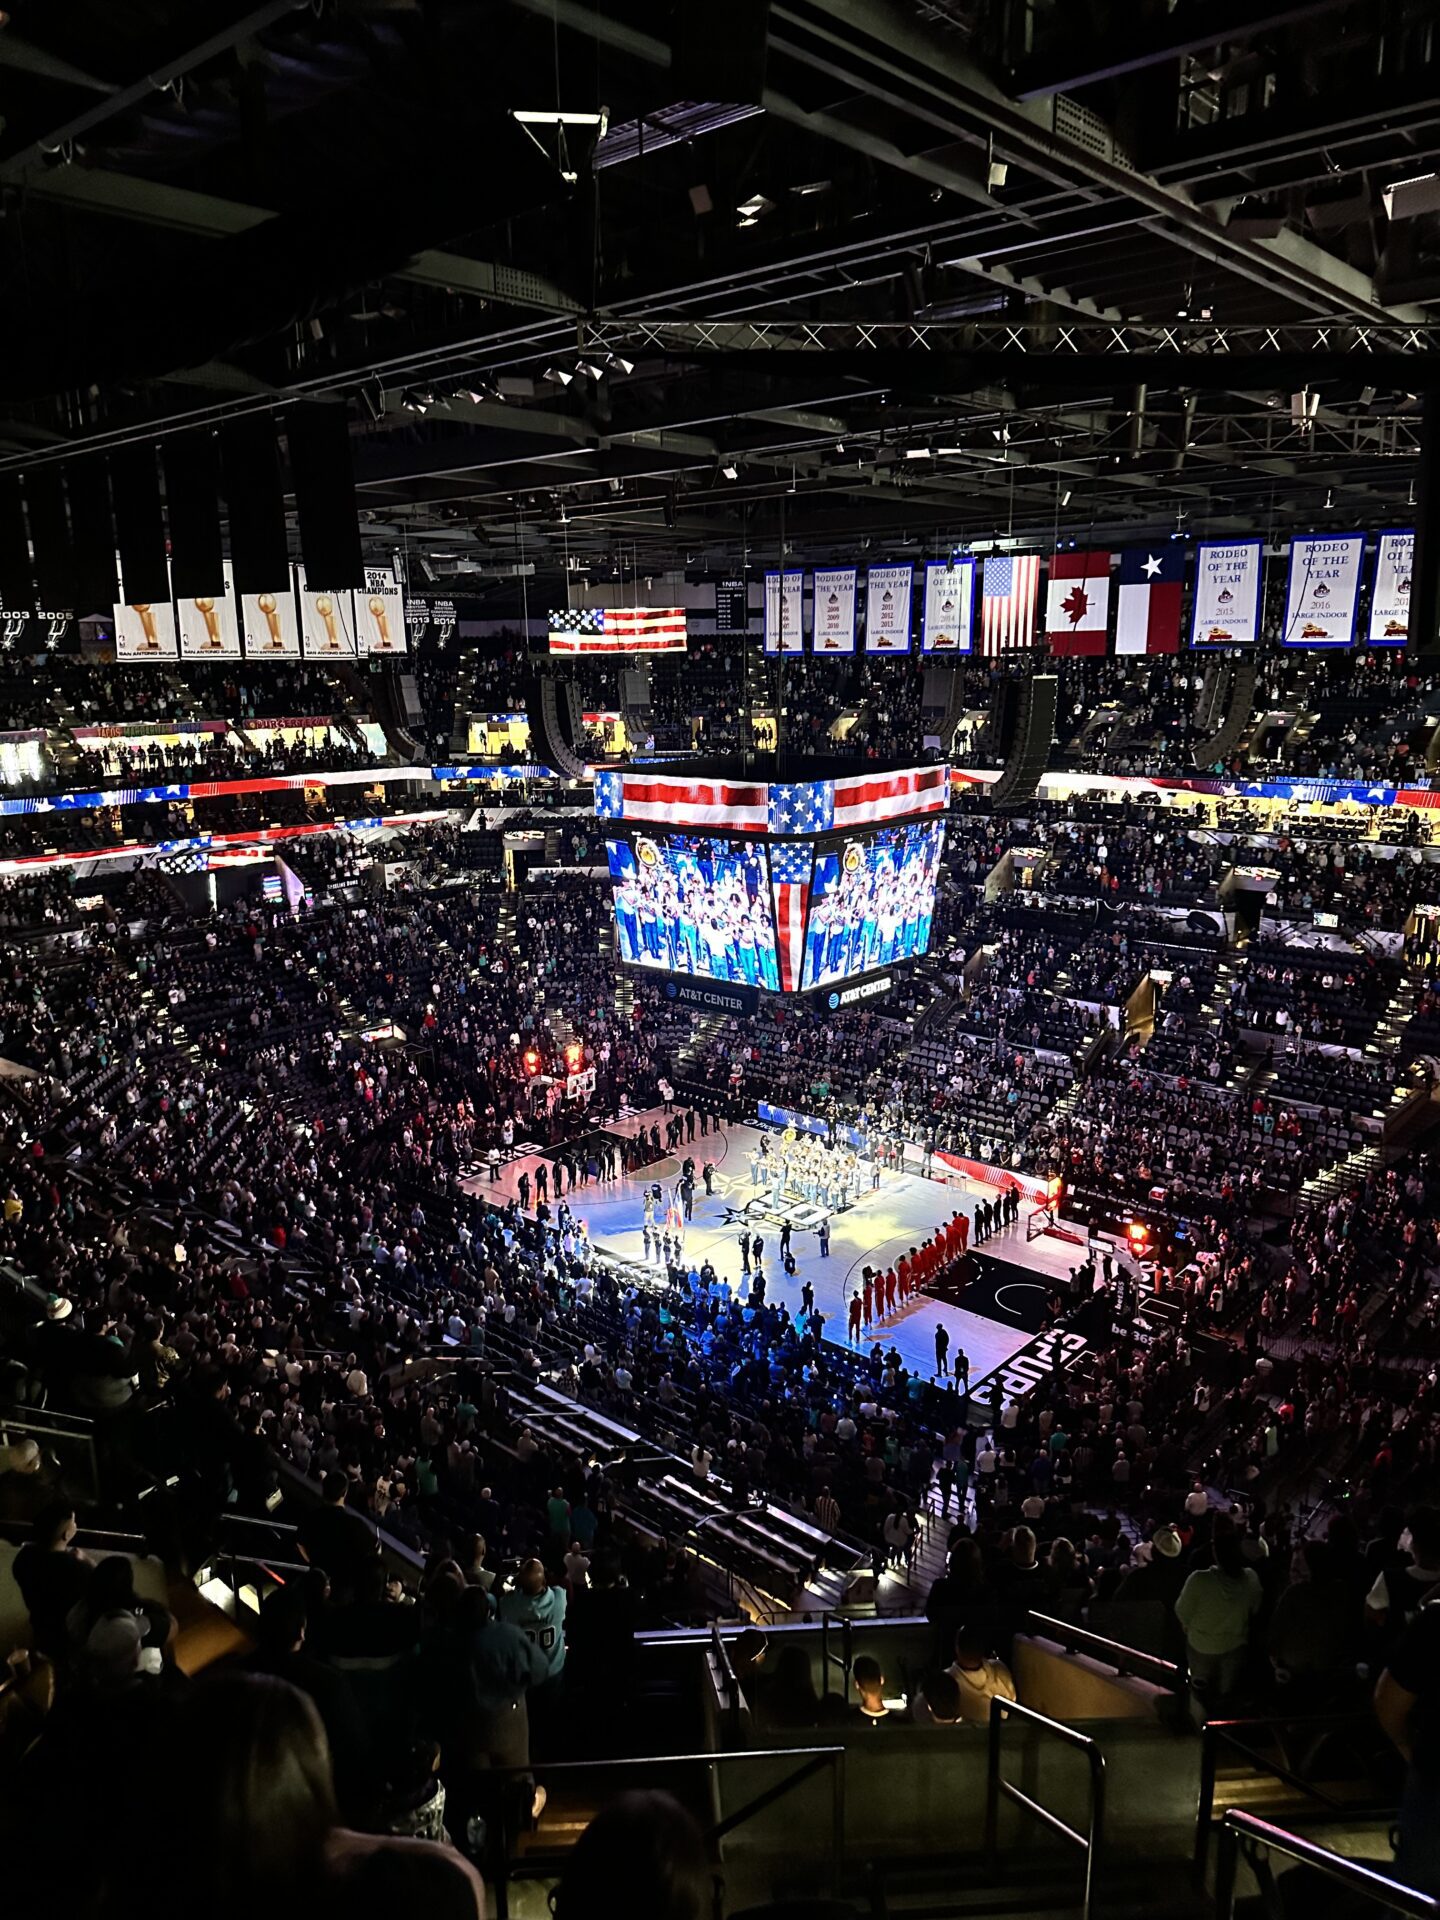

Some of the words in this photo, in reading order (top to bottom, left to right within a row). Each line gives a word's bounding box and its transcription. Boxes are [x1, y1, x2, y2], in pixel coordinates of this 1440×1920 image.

[1305, 543, 1349, 553] RODEO
[1210, 549, 1248, 559] RODEO
[1303, 558, 1318, 566] OF
[1323, 556, 1349, 565] THE
[1208, 563, 1222, 571] OF
[1226, 562, 1248, 571] THE
[367, 572, 386, 580] 2014
[816, 574, 842, 582] RODEO
[869, 571, 897, 579] RODEO
[1309, 570, 1340, 578] YEAR
[1213, 575, 1241, 584] YEAR
[833, 584, 854, 592] YEAR
[1310, 601, 1330, 610] 2016
[0, 611, 30, 619] 003
[37, 611, 74, 620] 2005
[1216, 607, 1234, 616] 2015
[860, 977, 891, 998] CENTER
[679, 987, 703, 1001] AT&T
[703, 993, 743, 1010] CENTER
